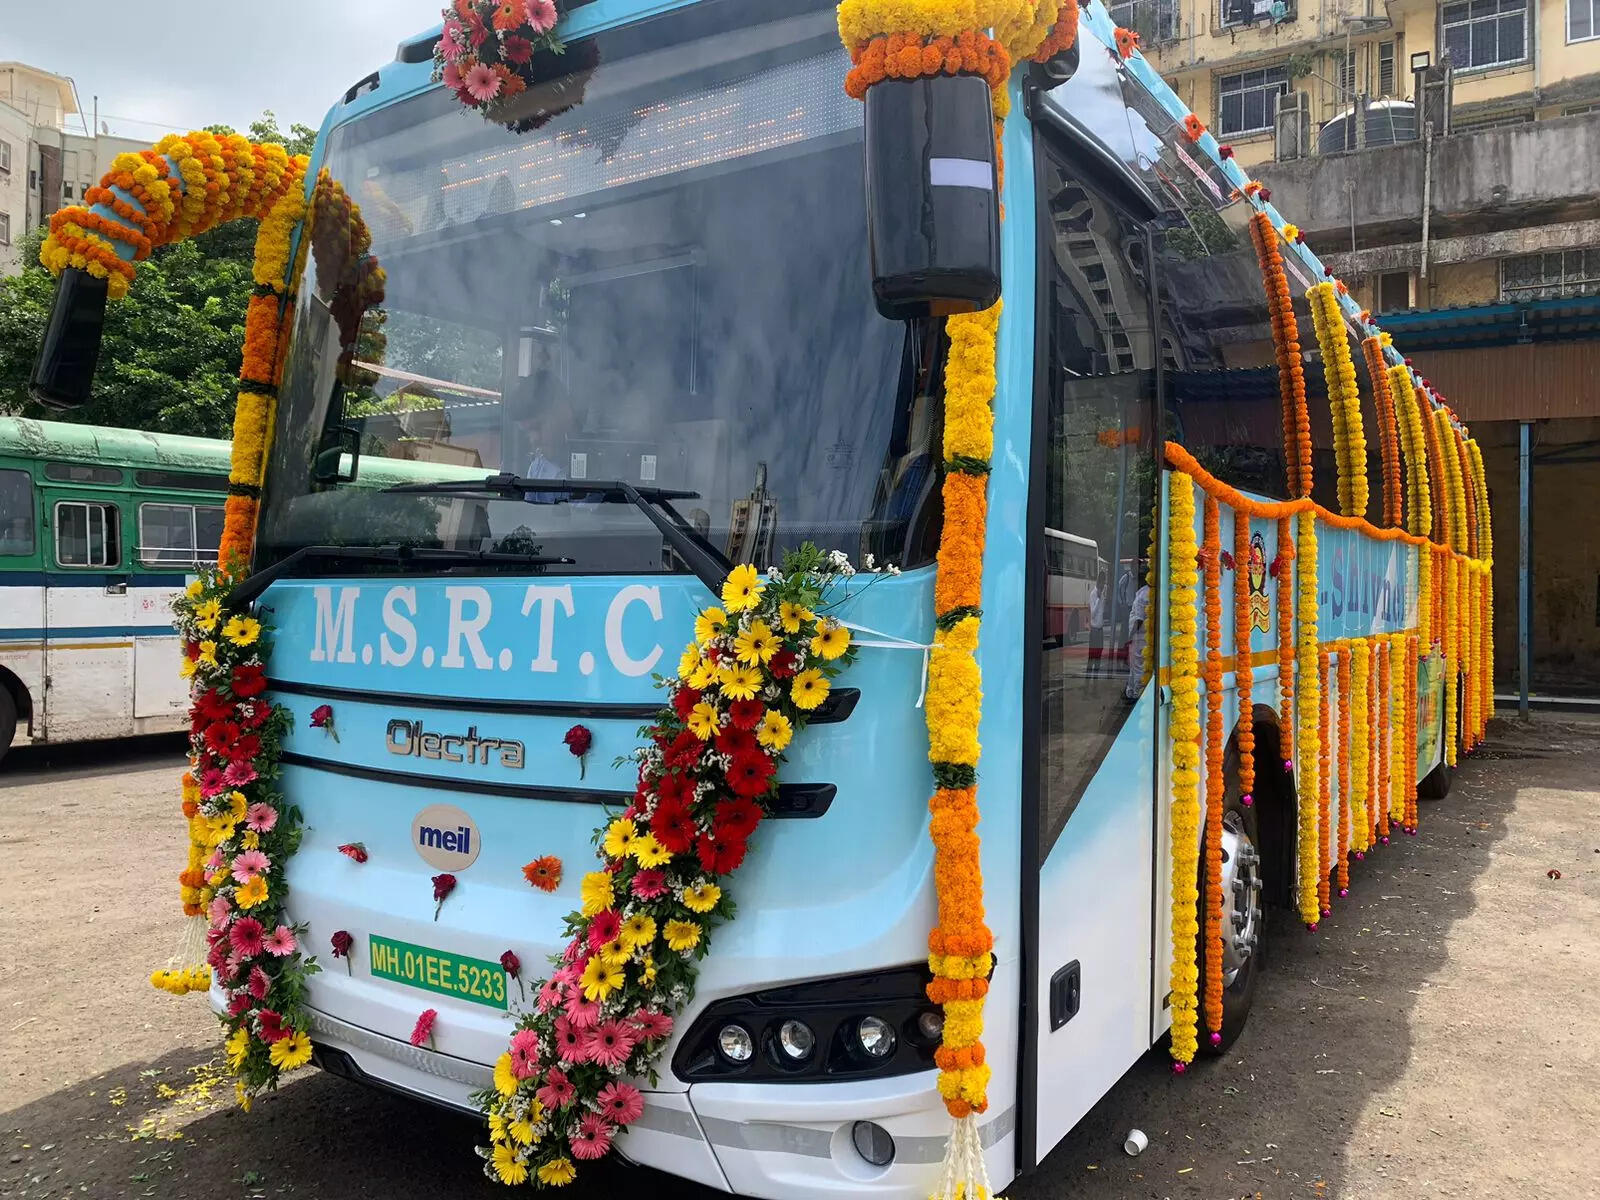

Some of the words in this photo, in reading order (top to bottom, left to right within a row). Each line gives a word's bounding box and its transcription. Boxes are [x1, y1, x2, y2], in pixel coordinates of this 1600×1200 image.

[310, 584, 664, 677] M.S.R.T.C
[386, 719, 525, 769] Olectra
[419, 826, 470, 854] meil
[371, 942, 505, 1002] MH.01EE.5233
